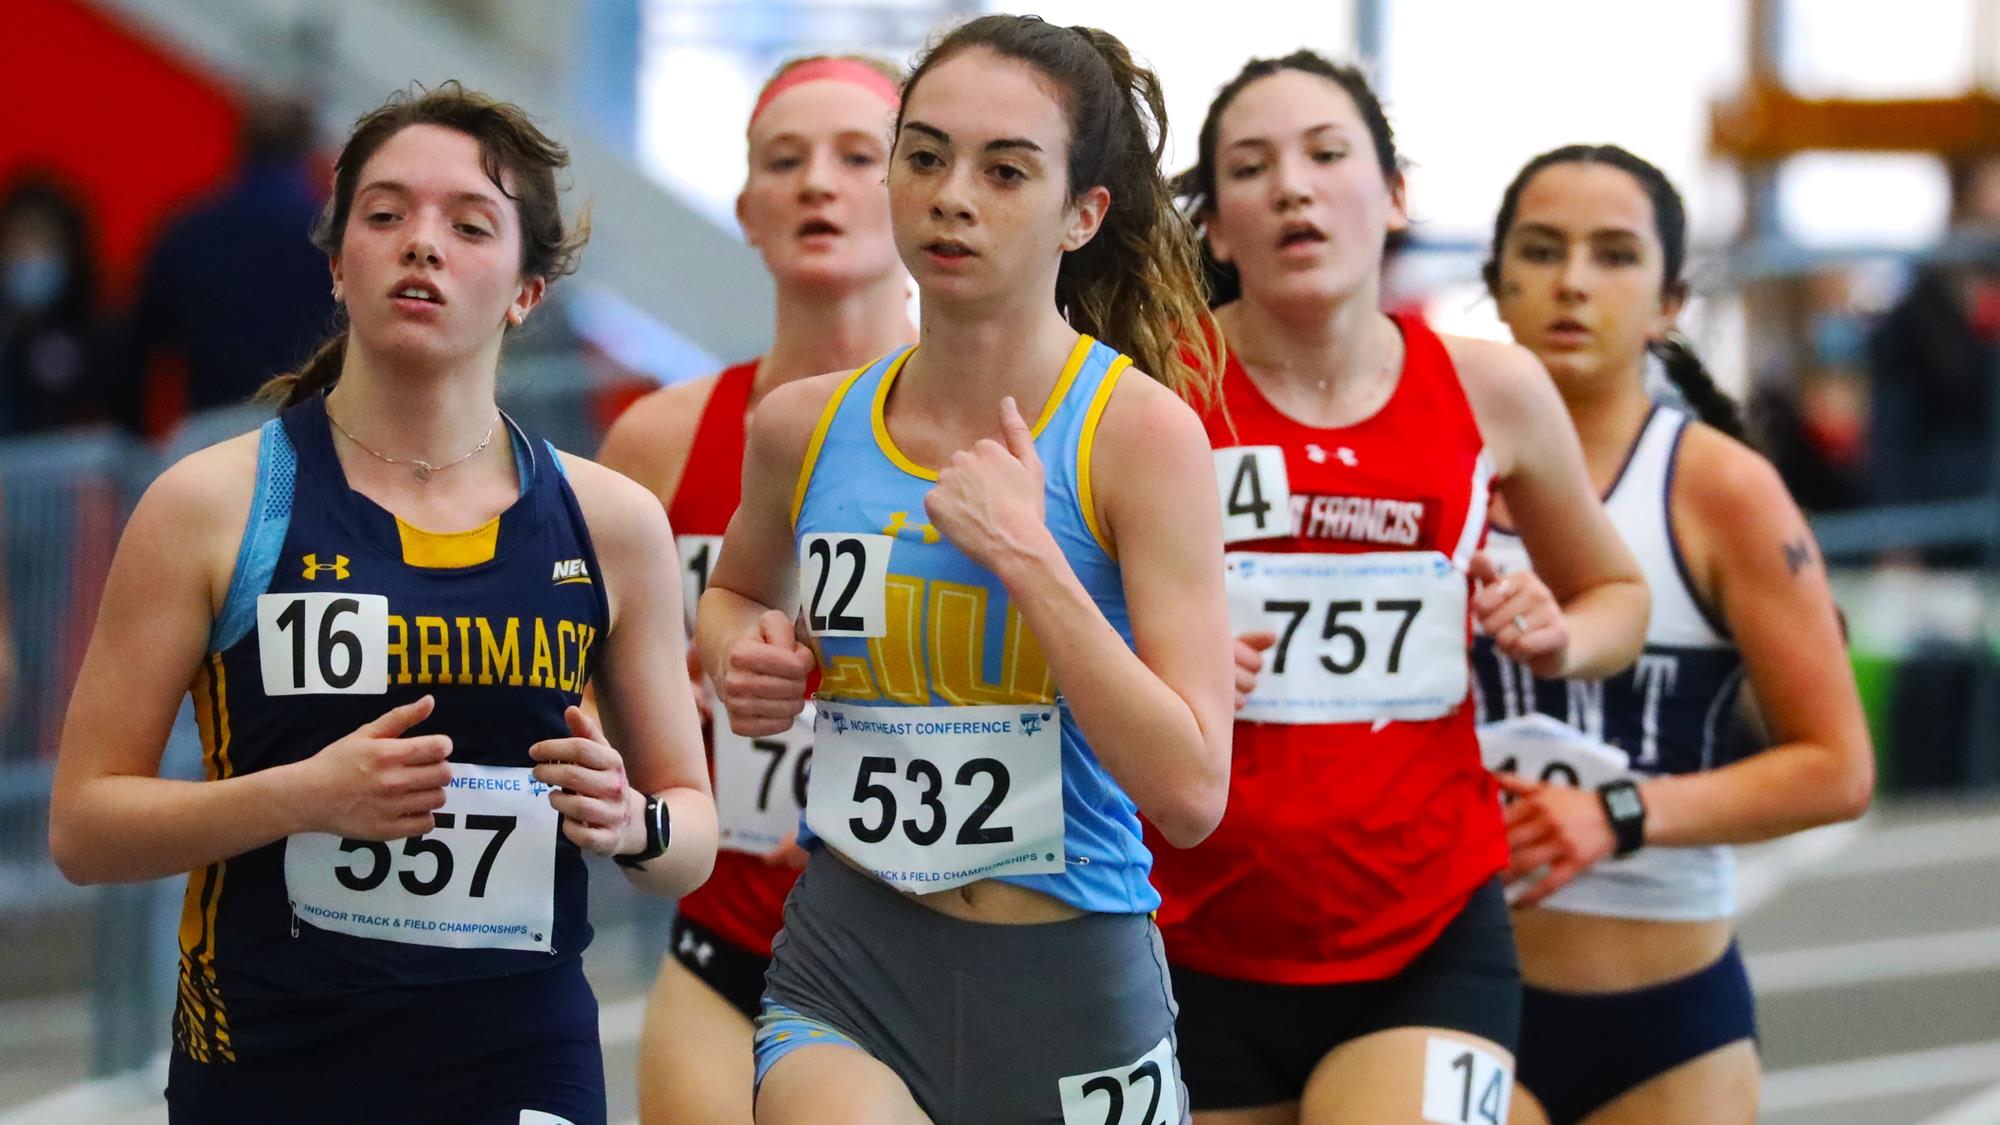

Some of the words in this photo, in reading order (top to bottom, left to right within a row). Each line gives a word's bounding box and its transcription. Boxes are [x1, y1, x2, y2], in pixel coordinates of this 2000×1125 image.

[1227, 453, 1271, 529] 4
[1305, 494, 1425, 546] FRANCIS
[808, 538, 867, 632] 22
[276, 598, 363, 689] 16
[1263, 599, 1423, 675] 757
[849, 719, 911, 735] NORTHEAST
[915, 720, 1011, 735] CONFERENCE
[444, 777, 521, 791] NFERENCE
[849, 756, 1014, 846] 532
[334, 812, 518, 898] 557
[909, 871, 940, 882] FIELD
[304, 904, 349, 922] INDOOR
[351, 913, 390, 927] TRACK
[392, 918, 401, 928] &
[404, 918, 436, 931] FIELD
[438, 922, 528, 935] CHAMPIONSHIPS
